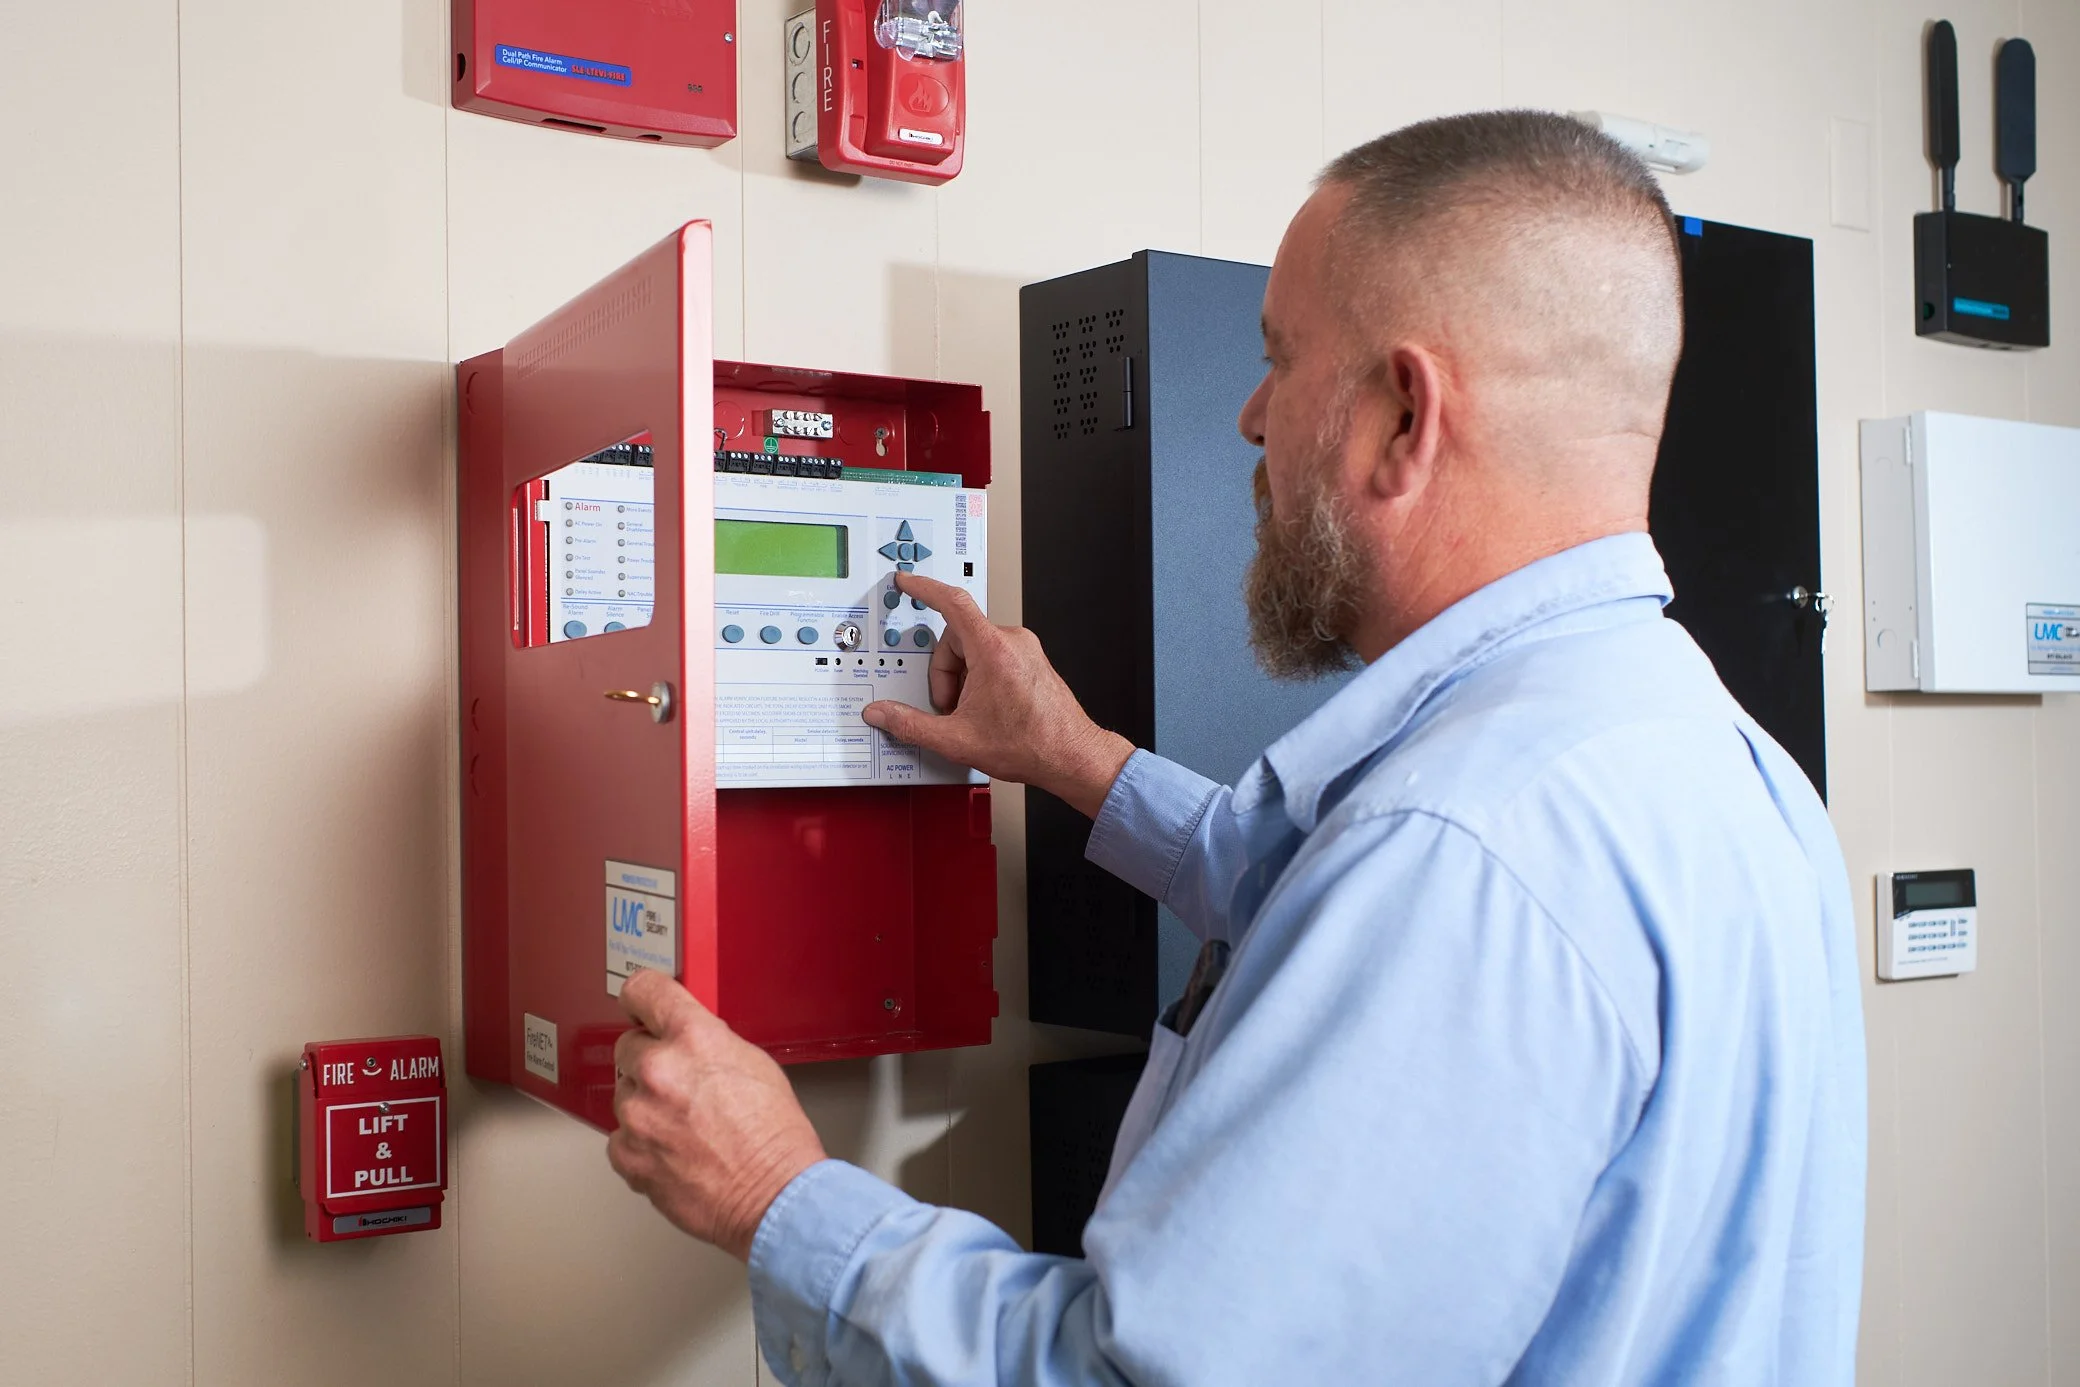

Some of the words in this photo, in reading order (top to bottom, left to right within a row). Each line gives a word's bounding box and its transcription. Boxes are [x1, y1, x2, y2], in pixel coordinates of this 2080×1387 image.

[502, 48, 516, 58] Dual
[518, 51, 531, 60] Path
[532, 54, 544, 62] Fire
[544, 56, 562, 65] Alarm
[502, 56, 522, 66] Cell/IP
[524, 60, 567, 73] Communicator
[822, 20, 833, 113] FIRE
[575, 502, 600, 512] Alarm
[646, 921, 668, 936] SECURITY
[323, 1062, 355, 1086] FIRE
[390, 1056, 439, 1081] ALARM
[358, 1114, 408, 1135] LIFT
[376, 1142, 392, 1160] &
[354, 1166, 413, 1188] PULL
